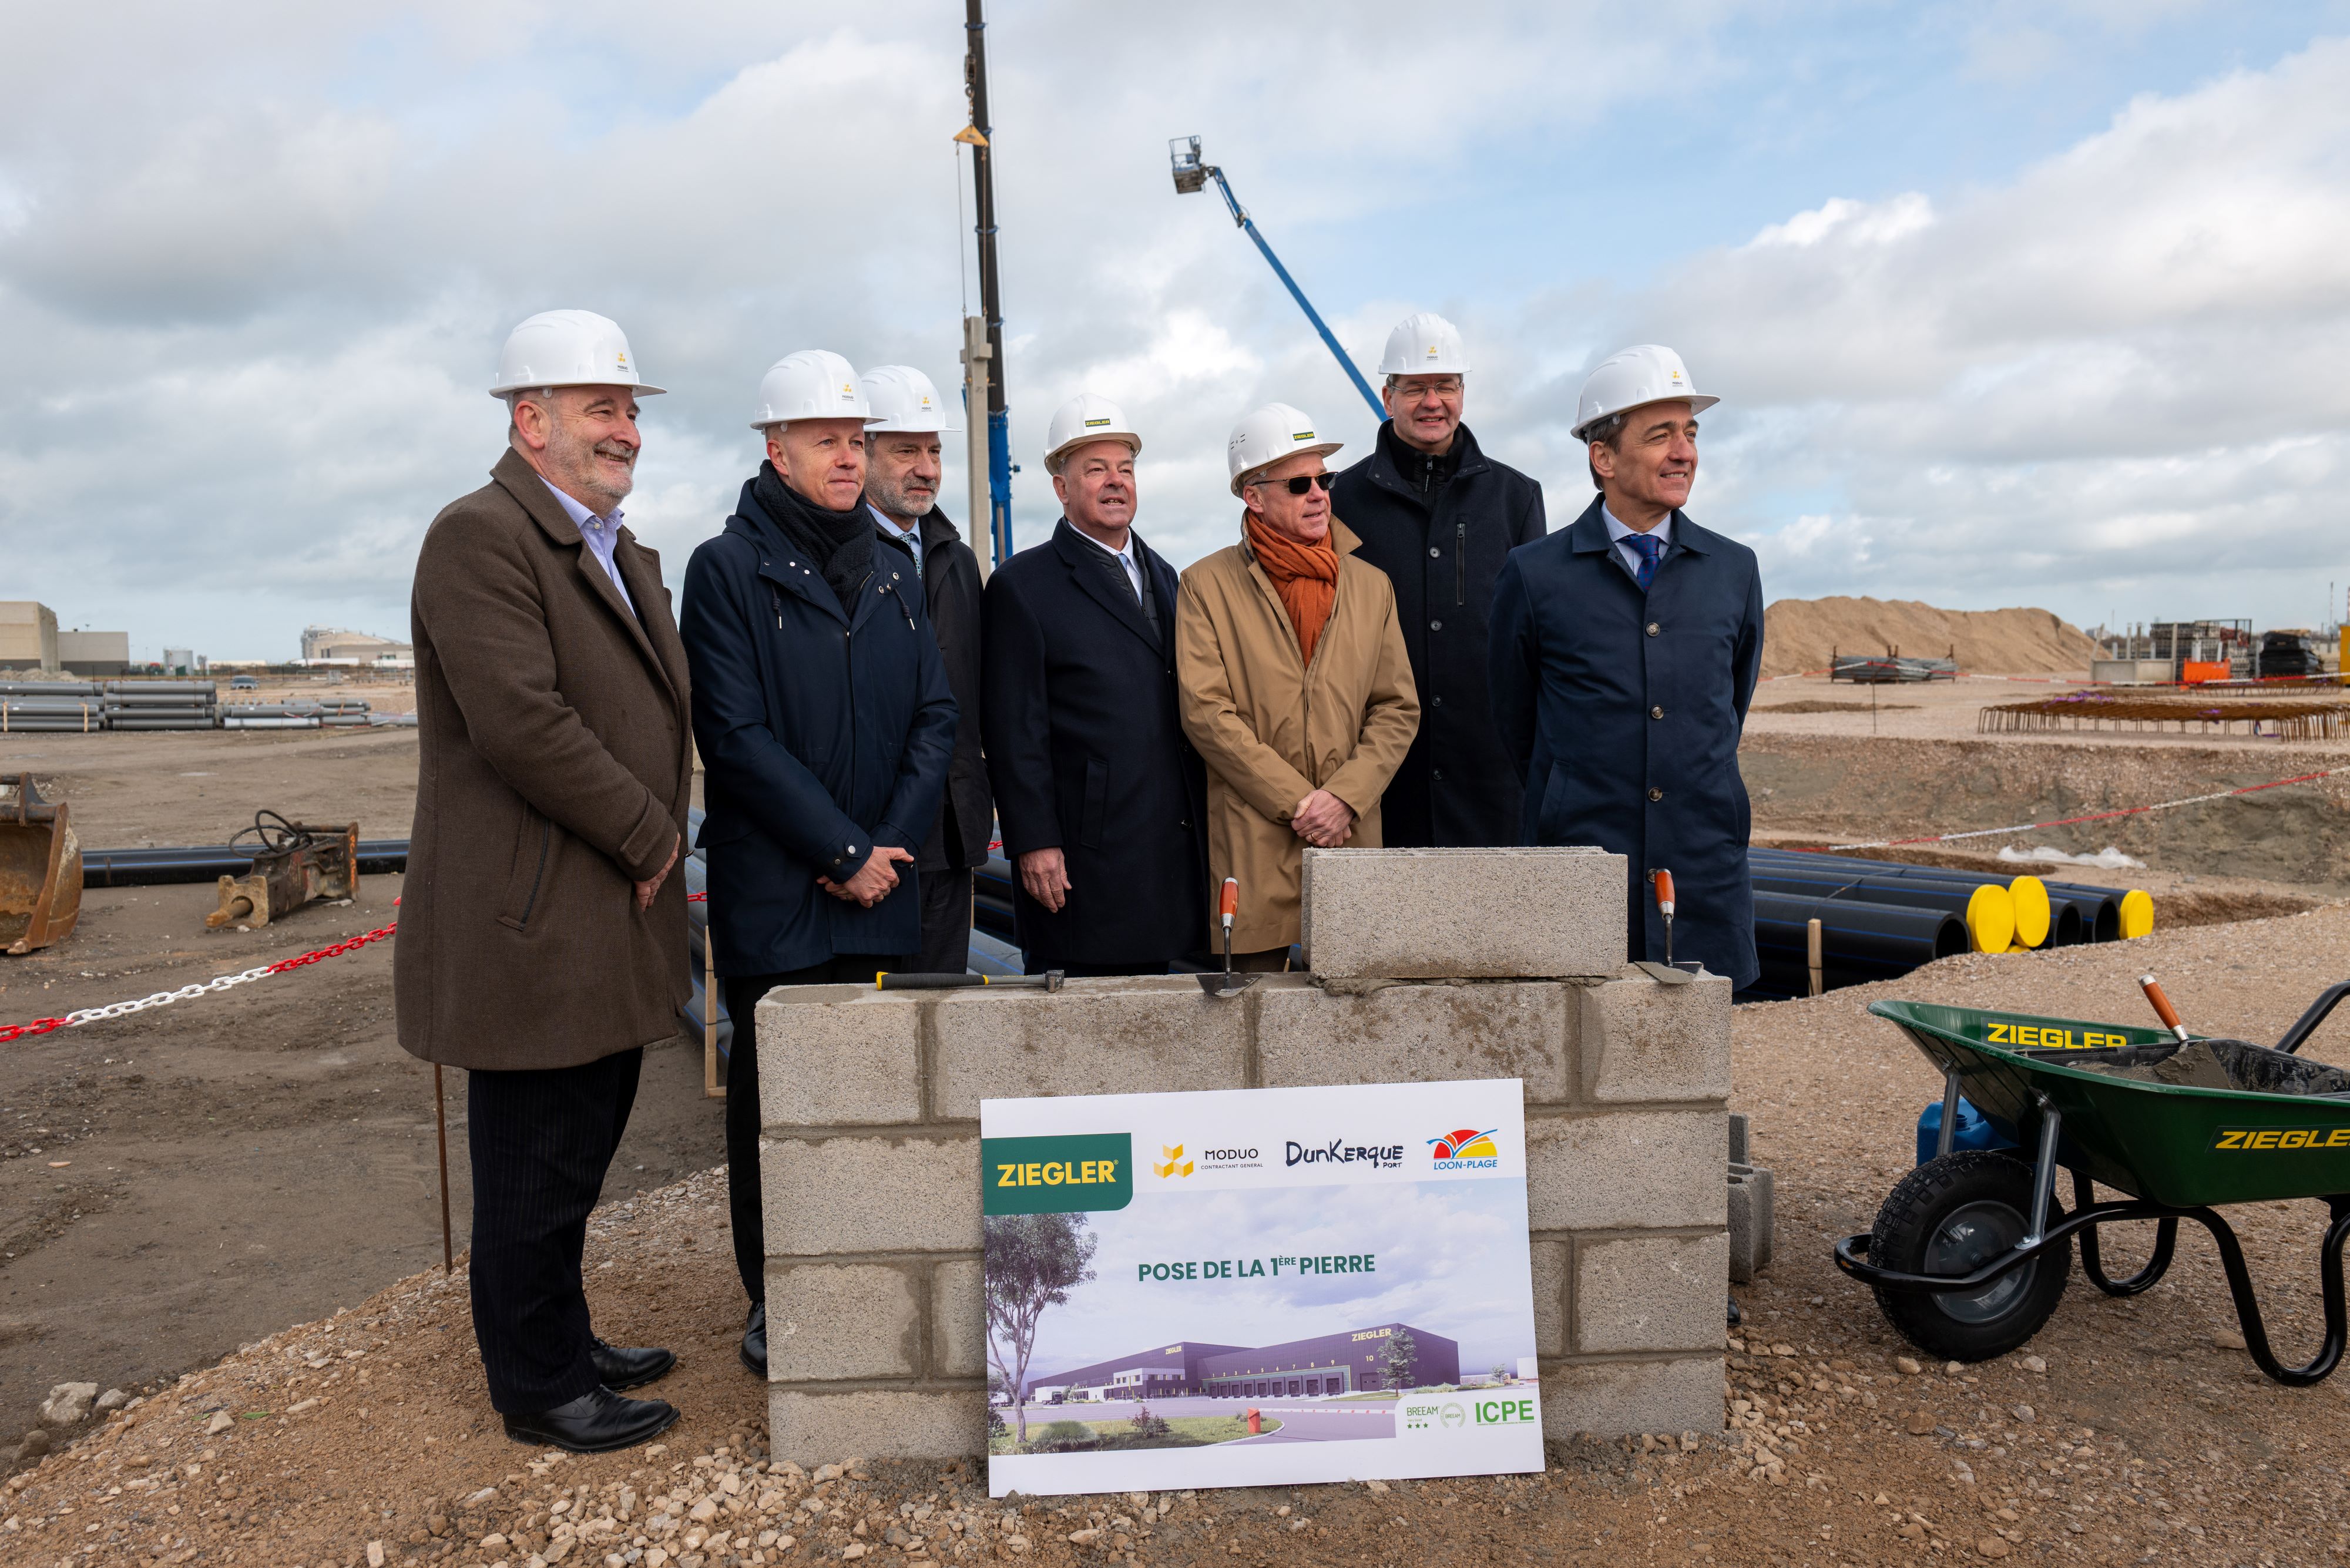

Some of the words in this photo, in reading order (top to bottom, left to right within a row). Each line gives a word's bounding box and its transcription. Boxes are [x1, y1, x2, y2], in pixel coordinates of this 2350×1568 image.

[2215, 1129, 2350, 1149] ZIEGLE
[1205, 1148, 1258, 1160] MODUO
[1434, 1159, 1498, 1170] LOON-PLAGE
[1139, 1262, 1197, 1282] POSE
[1203, 1260, 1232, 1279] DE
[1238, 1259, 1265, 1278] LA
[1300, 1254, 1375, 1275] PIERRE
[1351, 1328, 1392, 1342] ZIEGLER
[1165, 1345, 1182, 1355] ZIEGLER
[1406, 1406, 1438, 1416] BREEAM
[1475, 1399, 1535, 1423] ICPE
